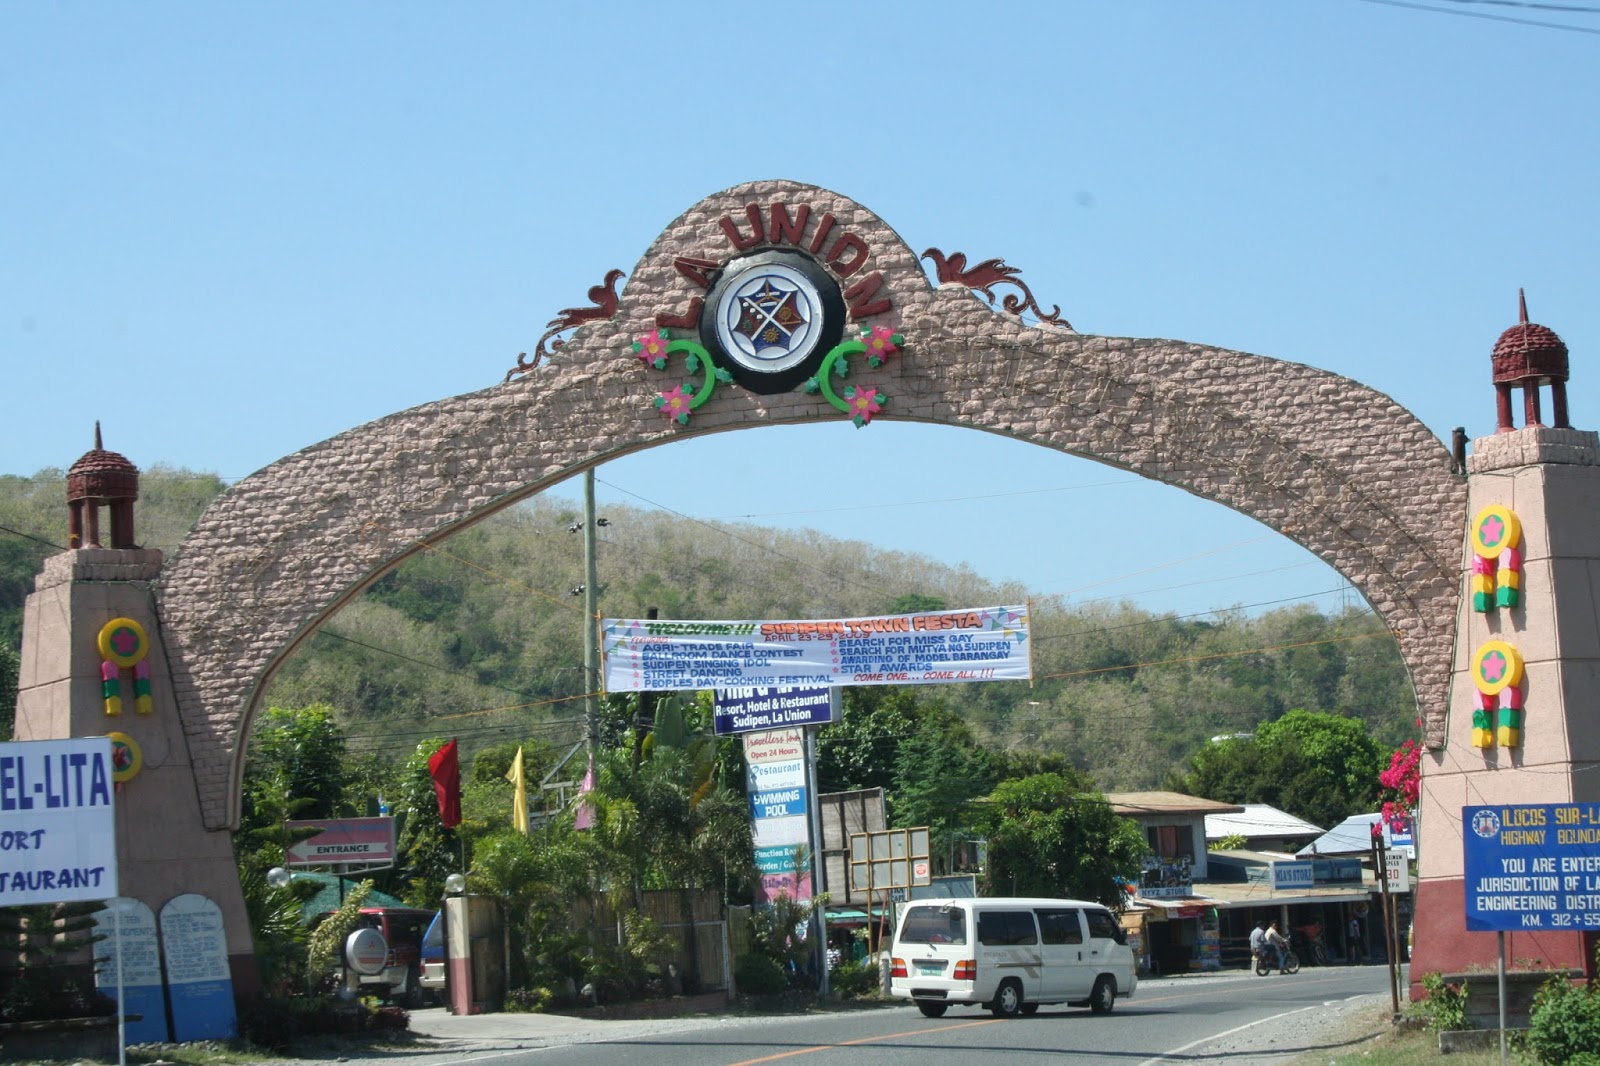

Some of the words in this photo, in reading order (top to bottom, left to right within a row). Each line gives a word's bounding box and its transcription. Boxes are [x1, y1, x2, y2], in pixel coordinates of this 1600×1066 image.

[656, 257, 718, 329] LA
[718, 202, 893, 319] UNION
[761, 622, 843, 634] SUDIPEN
[845, 616, 910, 634] TOWN
[912, 612, 983, 632] FIESTA
[764, 632, 795, 642] APRIL
[839, 638, 884, 647] SEARCH
[888, 637, 911, 645] FOR
[914, 635, 945, 644] MISS
[949, 633, 973, 642] GAY
[643, 643, 722, 651] AGRI-TRADE
[726, 641, 754, 650] FAIR
[840, 647, 881, 655] SEARCH
[885, 646, 904, 654] FOR
[908, 644, 946, 653] MUTYA
[948, 643, 963, 652] NG
[964, 641, 1010, 650] SUDIPEN
[642, 651, 706, 659] BALLROOM
[711, 649, 750, 658] DANCE
[753, 649, 803, 657] CONTEST
[841, 655, 892, 664] AWARDING
[897, 654, 910, 662] OF
[915, 653, 950, 661] MODEL
[952, 650, 1009, 660] BARANGAY
[643, 660, 690, 669] SUDIPEN
[694, 660, 739, 668] SINGING
[743, 658, 770, 666] IDOL
[841, 664, 871, 673] STAR
[879, 662, 932, 672] AWARDS
[643, 669, 685, 678] STREET
[690, 668, 742, 677] DANCING
[923, 671, 953, 679] COME
[956, 670, 976, 678] ALL
[644, 678, 692, 687] PEOPLES
[779, 674, 834, 683] FESTIVAL
[715, 704, 745, 716] Resort,
[747, 698, 770, 712] Hotel
[771, 697, 779, 708] &
[780, 693, 828, 708] Restaurant
[733, 714, 771, 728] Sudipen,
[773, 711, 782, 722] La
[784, 709, 811, 720] Union
[750, 751, 767, 759] Open
[779, 747, 798, 755] Hours
[753, 789, 799, 804] SWIMMING
[765, 803, 788, 816] POOL
[1502, 808, 1547, 827] ILOCOS
[0, 829, 46, 851] ORT
[1500, 830, 1545, 845] HIGHWAY
[317, 844, 369, 853] ENTRANCE
[1501, 858, 1525, 872] YOU
[1532, 857, 1556, 872] ARE
[1561, 856, 1600, 871] ENTER
[1292, 868, 1312, 881] STORE
[1386, 869, 1399, 879] 30
[1476, 876, 1558, 892] JURISDICTION
[1564, 876, 1580, 890] OF
[1165, 887, 1186, 895] STORE
[1476, 895, 1556, 910] ENGINEERING
[1566, 894, 1600, 909] DISTR
[1521, 914, 1542, 926] KM.
